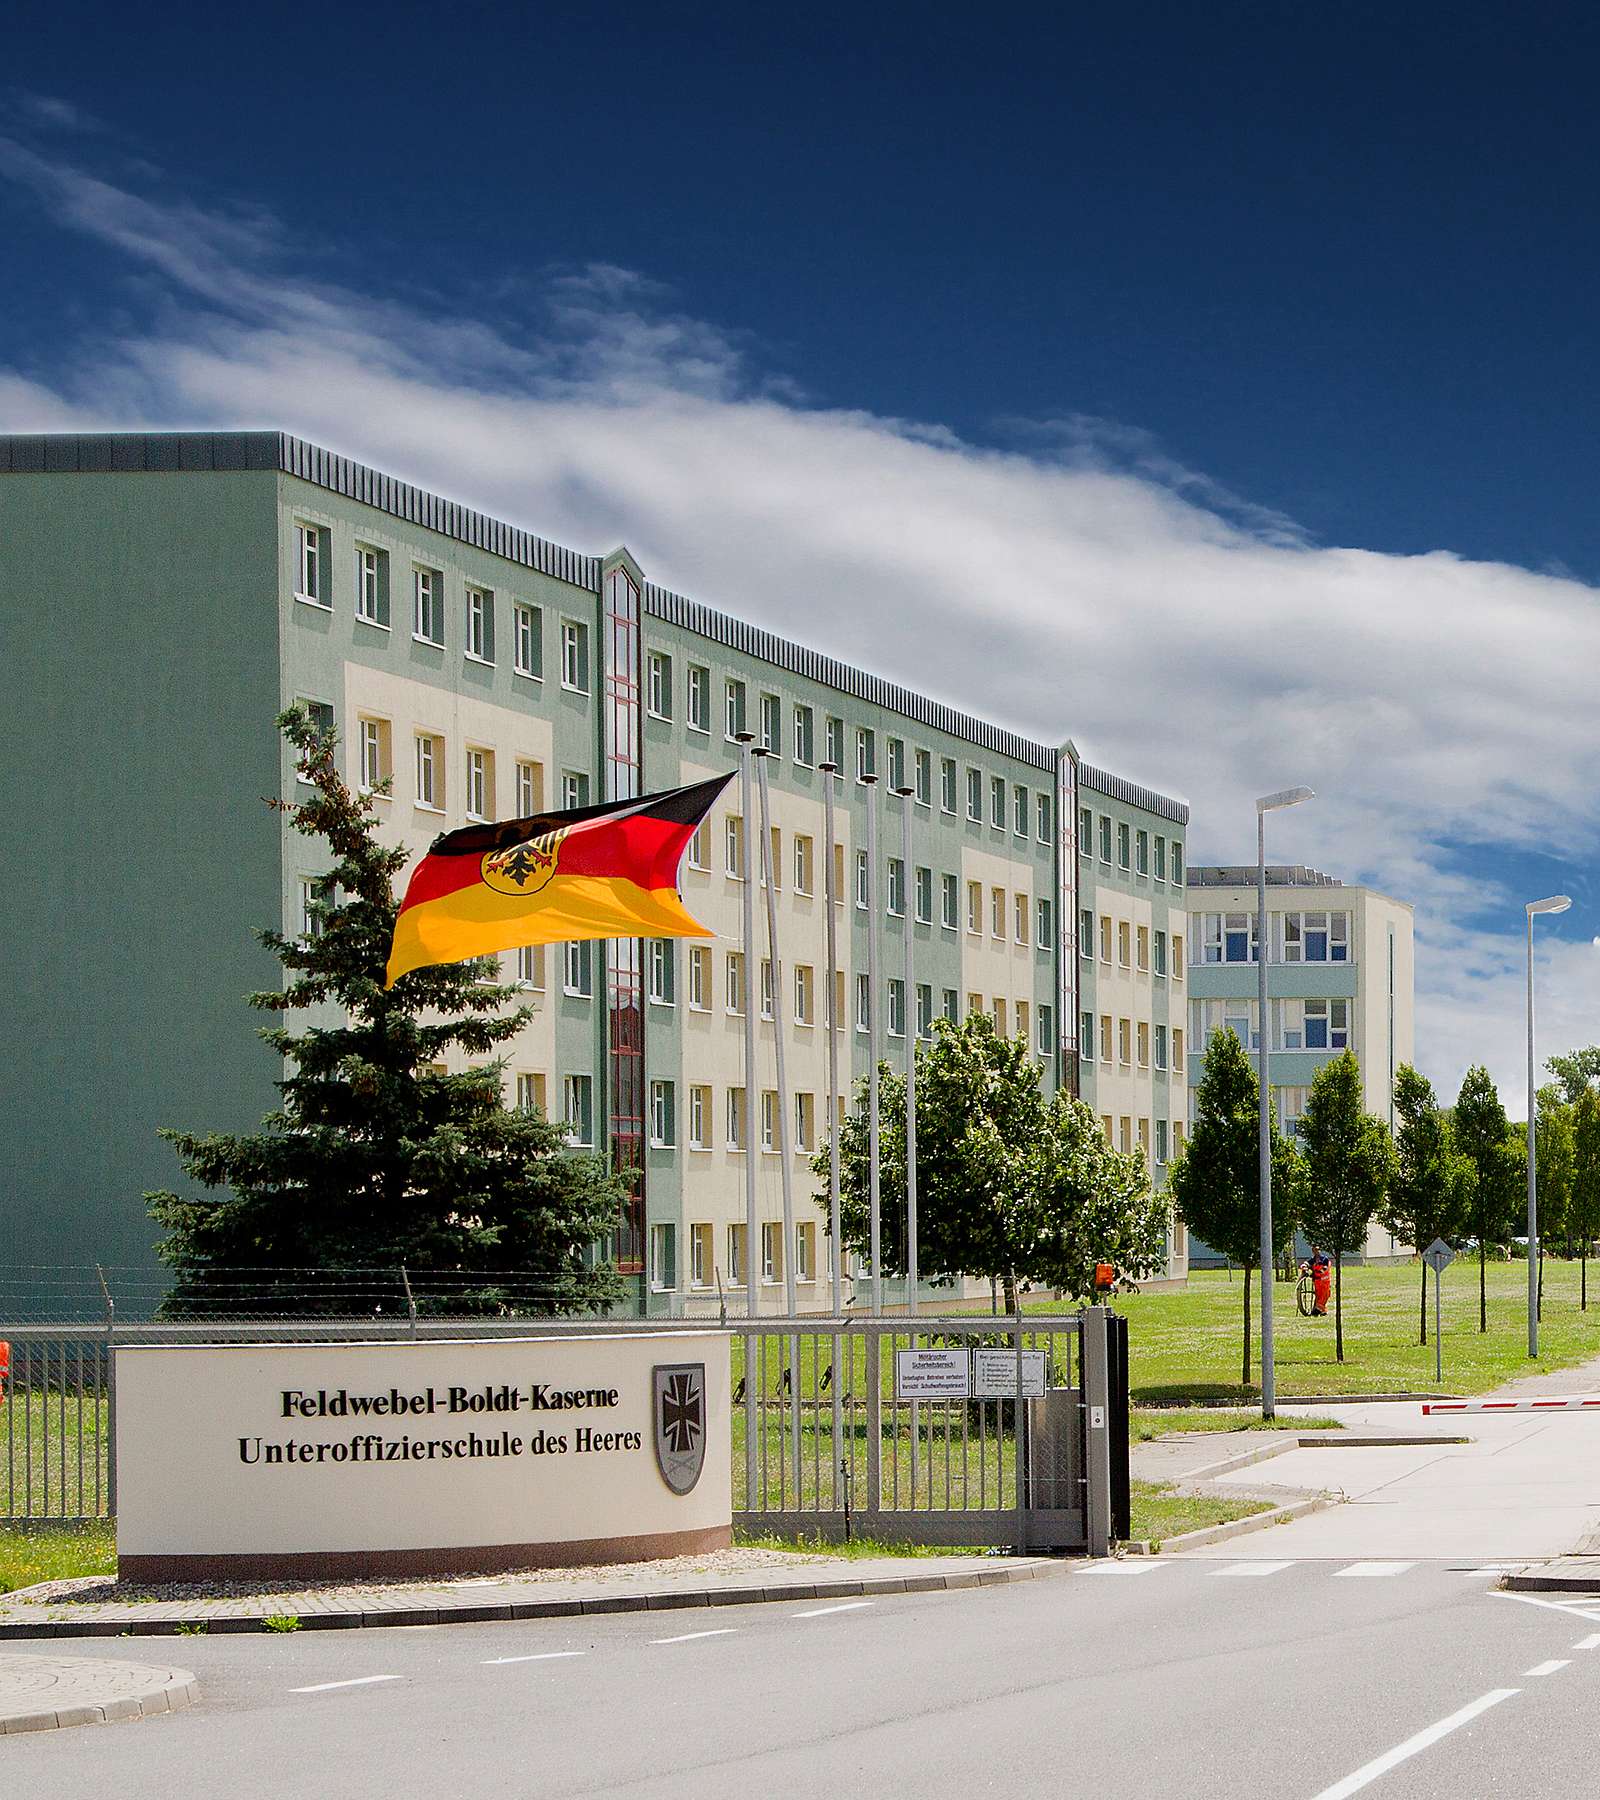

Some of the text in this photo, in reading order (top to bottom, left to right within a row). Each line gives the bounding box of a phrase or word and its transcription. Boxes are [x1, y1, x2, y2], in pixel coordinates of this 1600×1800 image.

[279, 1383, 620, 1418] Feldwebel-Boldt-Kaserne
[236, 1427, 642, 1464] Unteroffizierschule des Heeres
